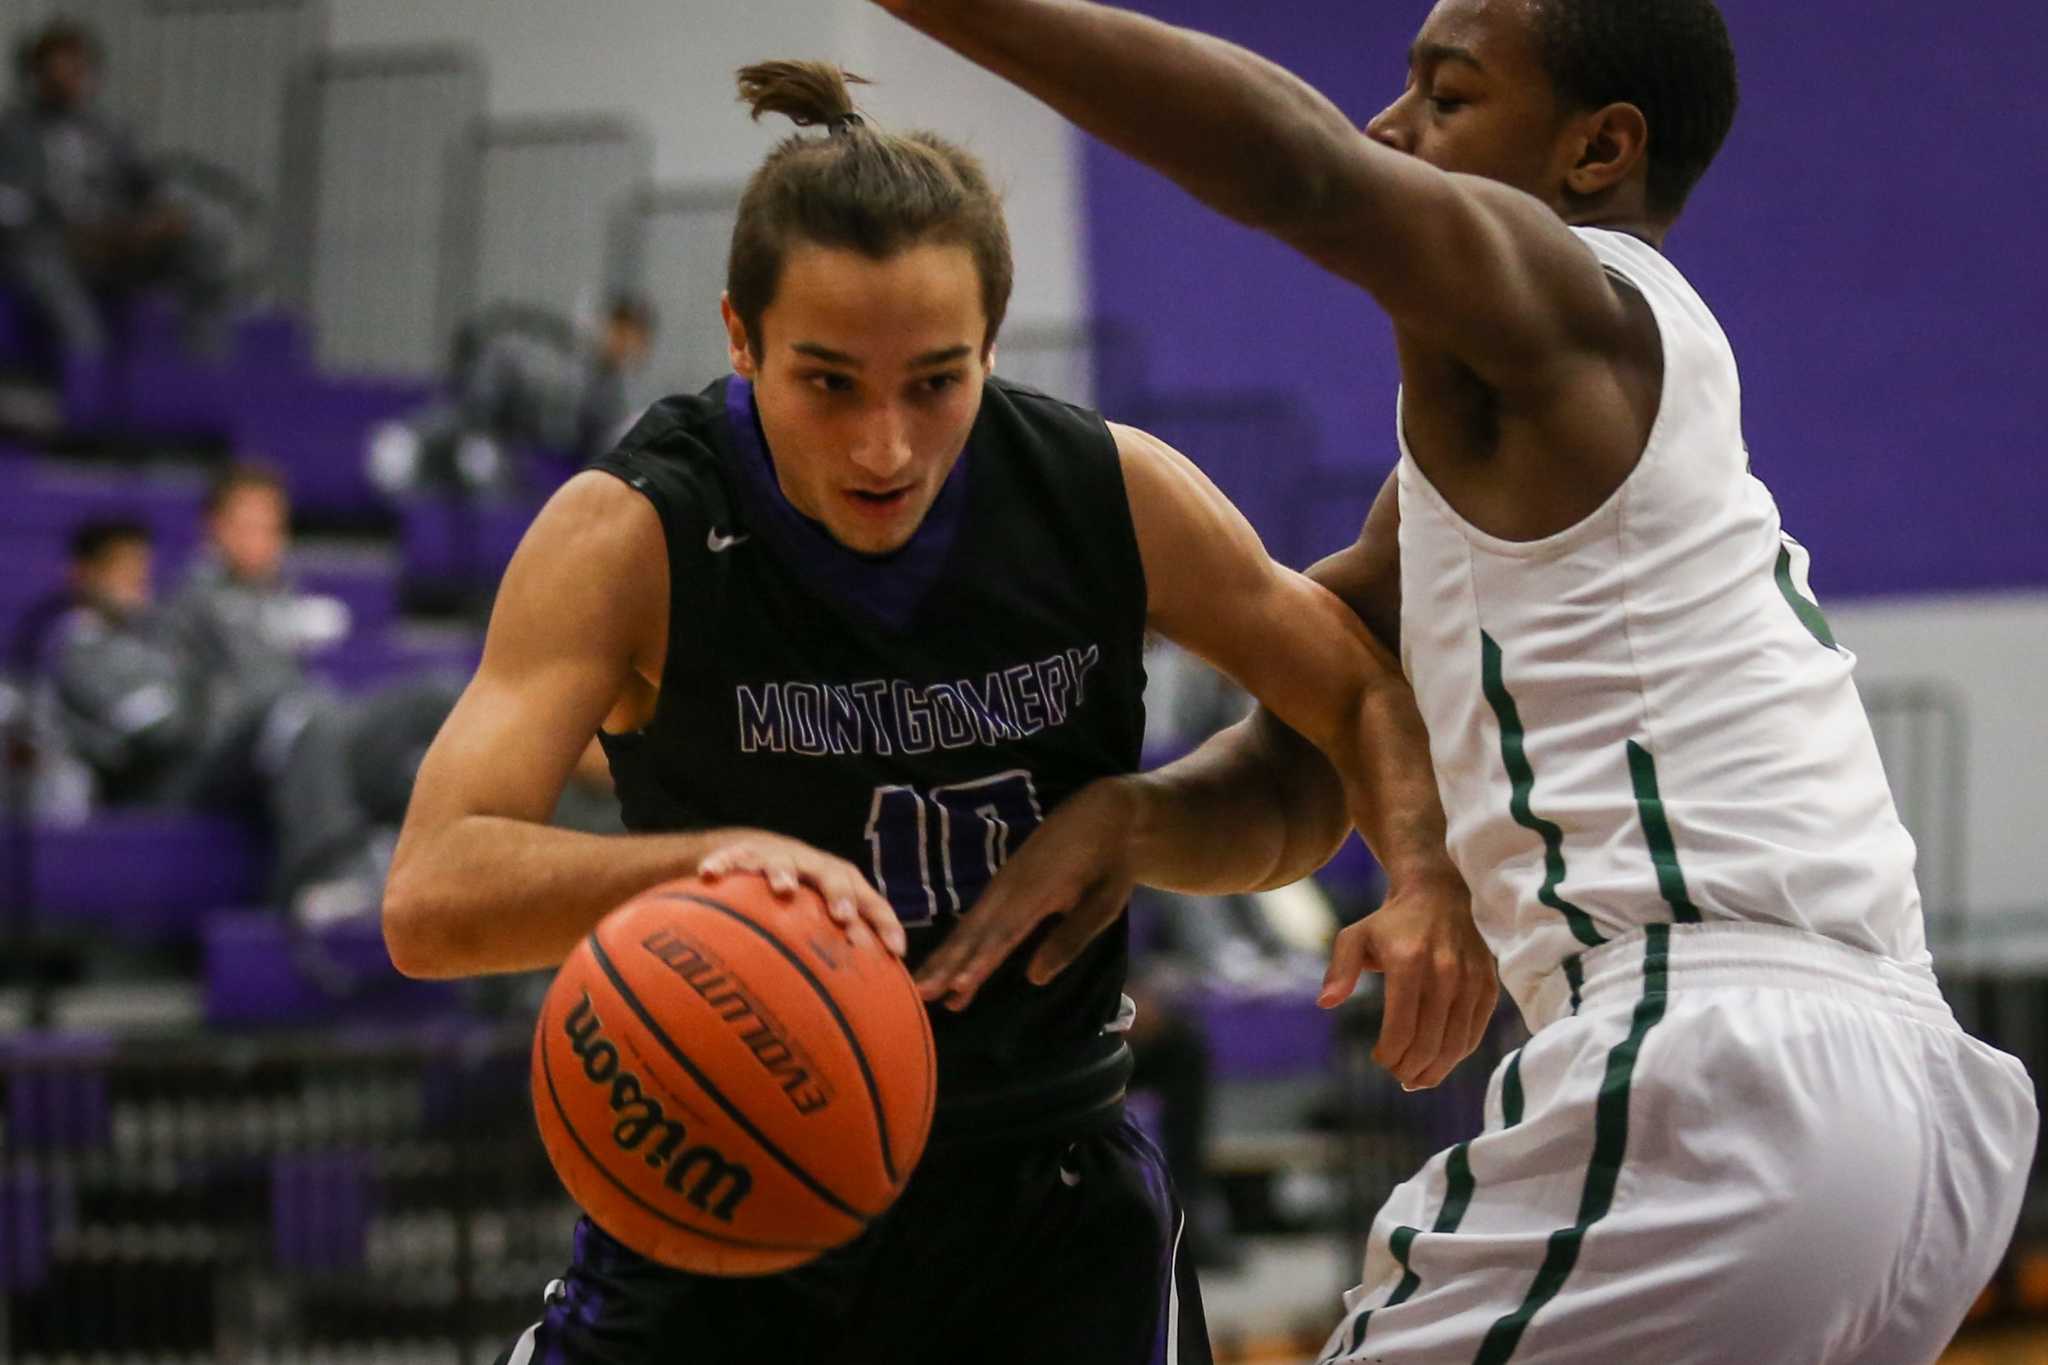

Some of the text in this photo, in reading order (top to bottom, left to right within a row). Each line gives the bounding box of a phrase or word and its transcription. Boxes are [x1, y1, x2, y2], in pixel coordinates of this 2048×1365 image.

[737, 644, 1099, 755] MONTGOMERY
[565, 988, 754, 1223] Wilson
[642, 928, 828, 1116] EVOLUTION
